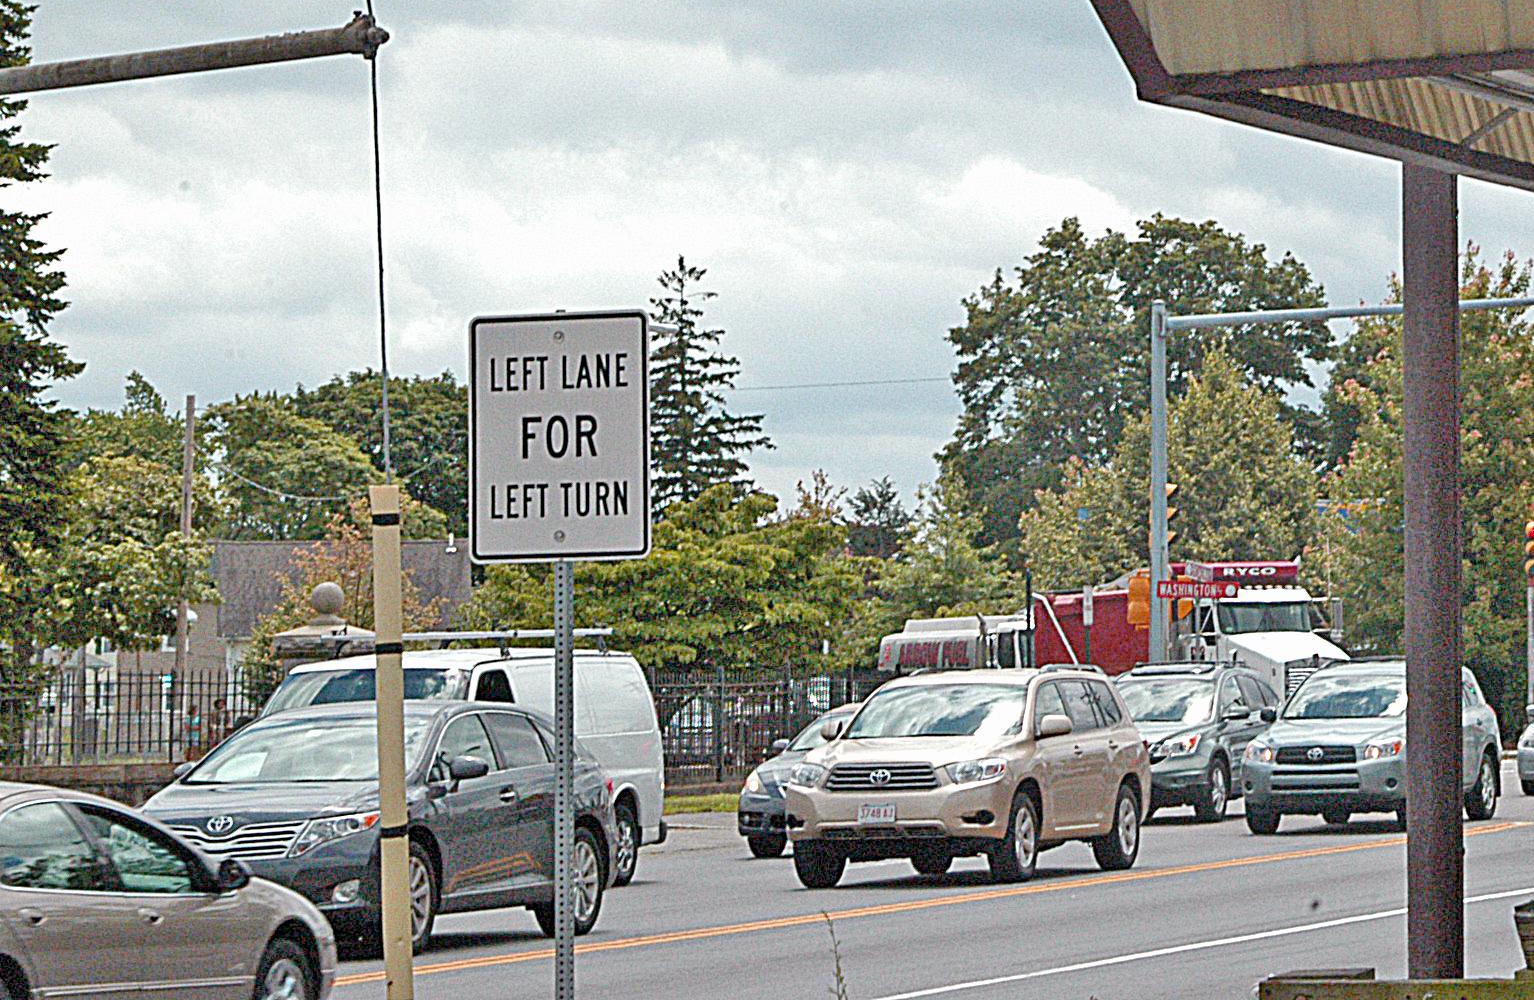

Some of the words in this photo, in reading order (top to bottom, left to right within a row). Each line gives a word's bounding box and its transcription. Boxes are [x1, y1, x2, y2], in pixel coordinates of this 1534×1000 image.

[491, 356, 548, 391] LEFT
[562, 353, 628, 389] LANE
[522, 414, 597, 459] FOR
[491, 484, 548, 519] LEFT
[560, 481, 628, 517] TURN
[1223, 566, 1277, 576] RYCO
[1160, 583, 1217, 598] WASHINGTON
